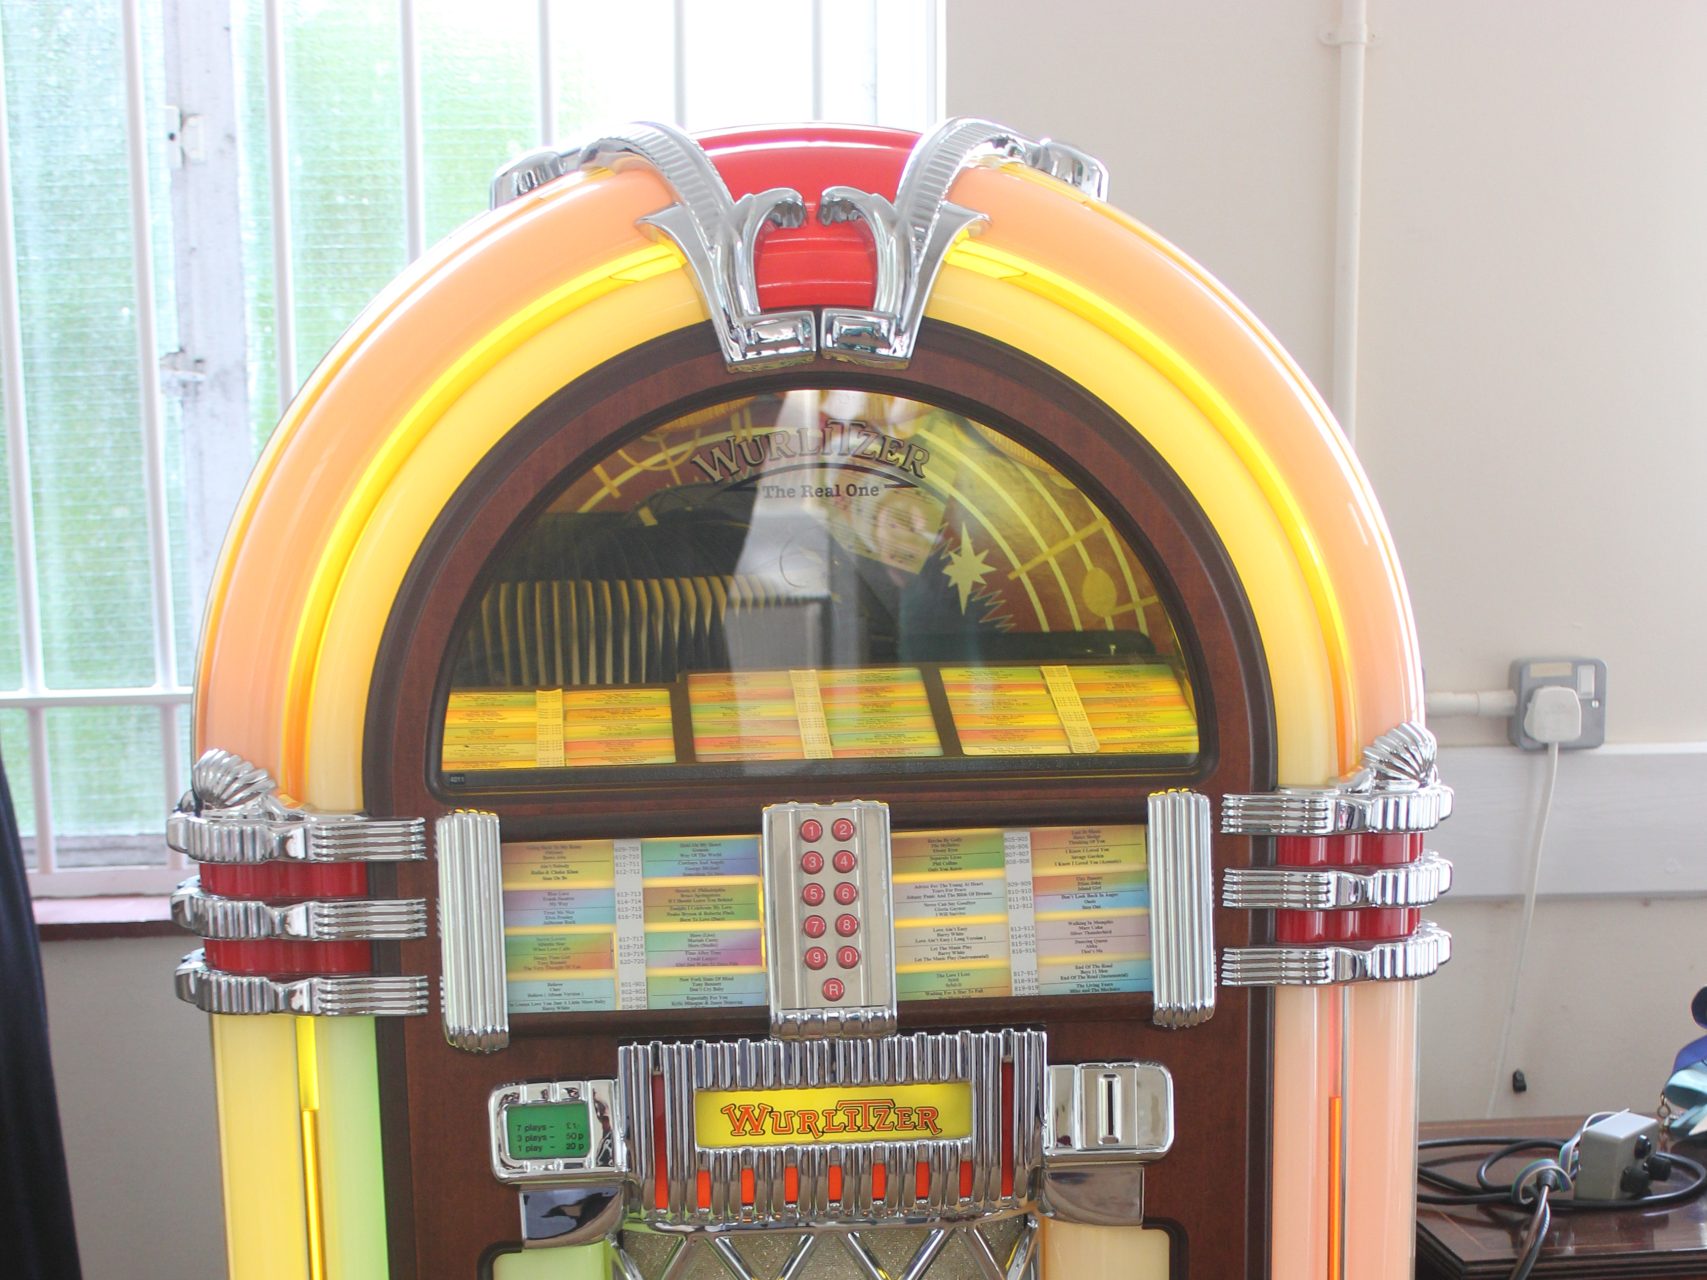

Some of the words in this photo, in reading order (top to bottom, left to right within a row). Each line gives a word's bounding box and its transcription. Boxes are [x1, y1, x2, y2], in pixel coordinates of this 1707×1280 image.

[692, 419, 930, 483] WURLITZER
[763, 485, 795, 499] The
[802, 485, 841, 498] Real
[846, 483, 879, 497] One
[809, 826, 814, 835] 1
[839, 825, 847, 835] 2
[809, 857, 816, 867] 3
[840, 856, 848, 865] 4
[810, 889, 817, 899] 5
[842, 888, 849, 898] 6
[811, 922, 819, 932] 7
[843, 920, 850, 930] 8
[813, 953, 820, 963] 9
[844, 952, 852, 962] 0
[829, 984, 838, 995] R
[721, 1099, 942, 1138] WURLITZER
[525, 1124, 546, 1132] plays
[525, 1134, 547, 1142] plays
